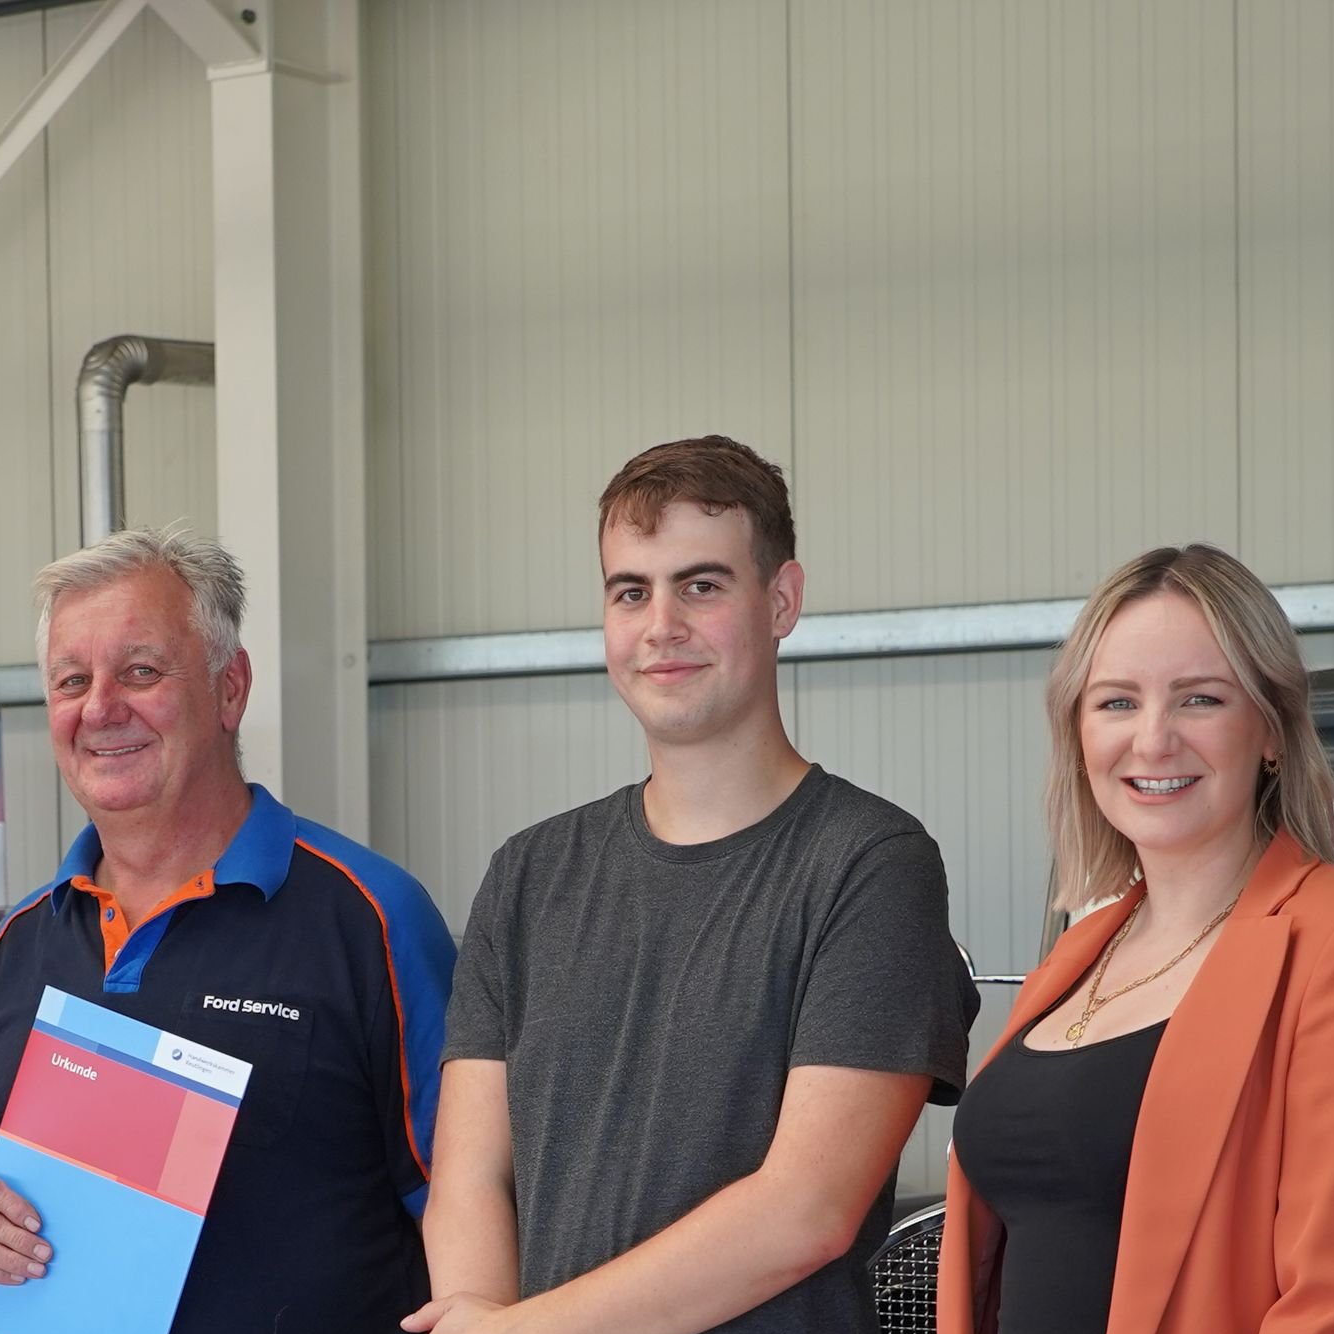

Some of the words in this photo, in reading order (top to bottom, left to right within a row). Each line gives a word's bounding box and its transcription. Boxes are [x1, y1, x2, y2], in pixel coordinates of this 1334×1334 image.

[203, 995, 240, 1012] Ford
[241, 999, 300, 1021] Service
[51, 1053, 98, 1081] Urkunde
